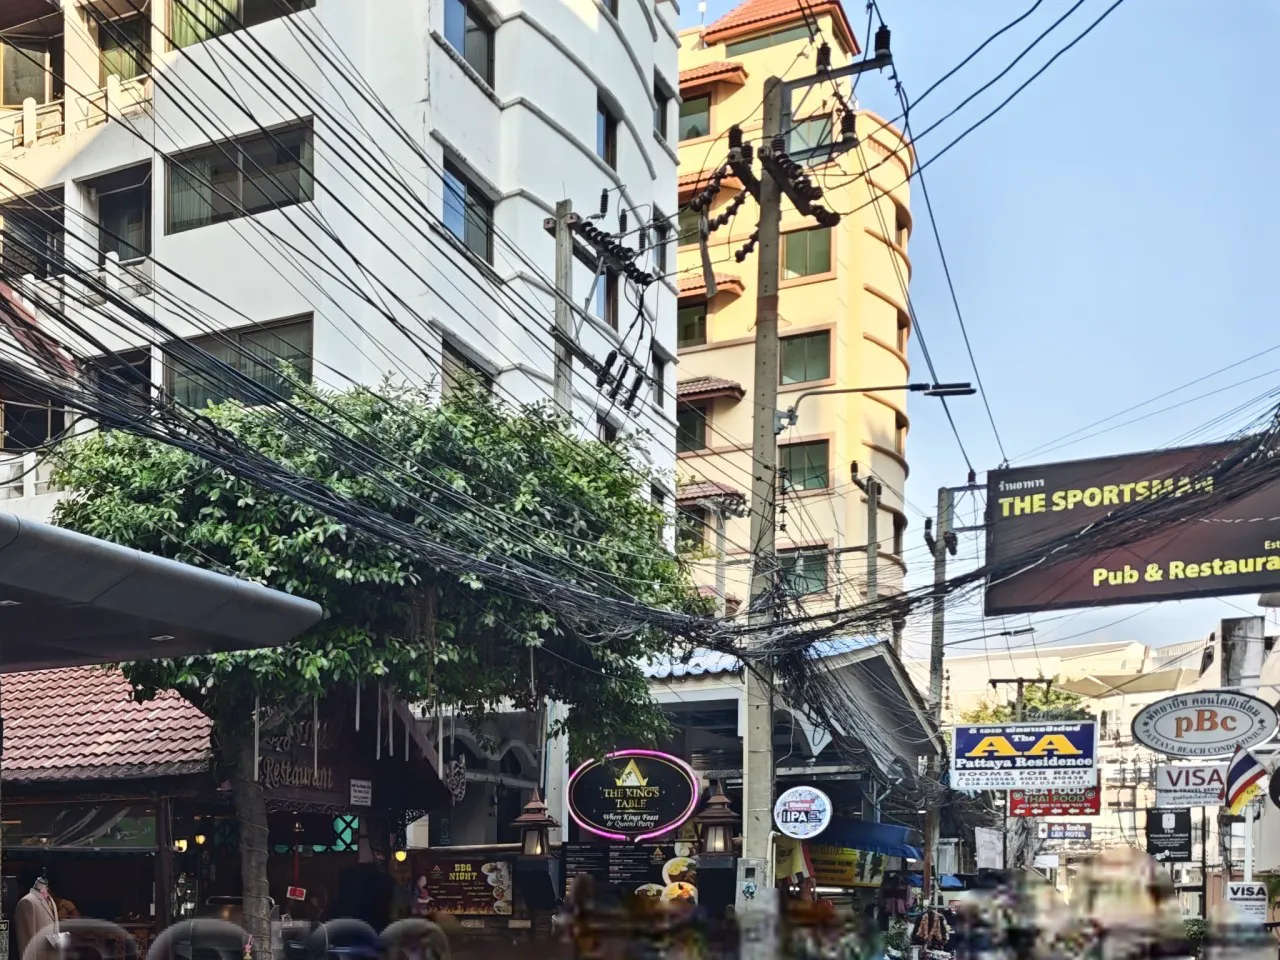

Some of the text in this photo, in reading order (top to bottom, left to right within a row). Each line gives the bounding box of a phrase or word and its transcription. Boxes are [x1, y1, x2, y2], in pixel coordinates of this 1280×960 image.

[998, 493, 1047, 517] THE
[1092, 564, 1139, 587] Pub
[1143, 562, 1164, 582] &
[1174, 709, 1238, 738] pBc
[1012, 734, 1036, 742] The
[1142, 729, 1175, 751] PATTAYA
[1177, 745, 1206, 754] BEACH
[965, 734, 1083, 757] AA
[955, 757, 1093, 770] Pattaya Residence
[1166, 768, 1224, 787] VISA
[603, 787, 660, 798] THE KING'S
[1051, 787, 1086, 795] FOOD
[615, 799, 647, 808] TABLE
[1024, 795, 1049, 803] THAI
[602, 813, 622, 821] Where
[623, 813, 641, 822] Kings
[637, 821, 655, 829] Party
[448, 872, 477, 880] NIGHT
[1230, 886, 1267, 897] VISA
